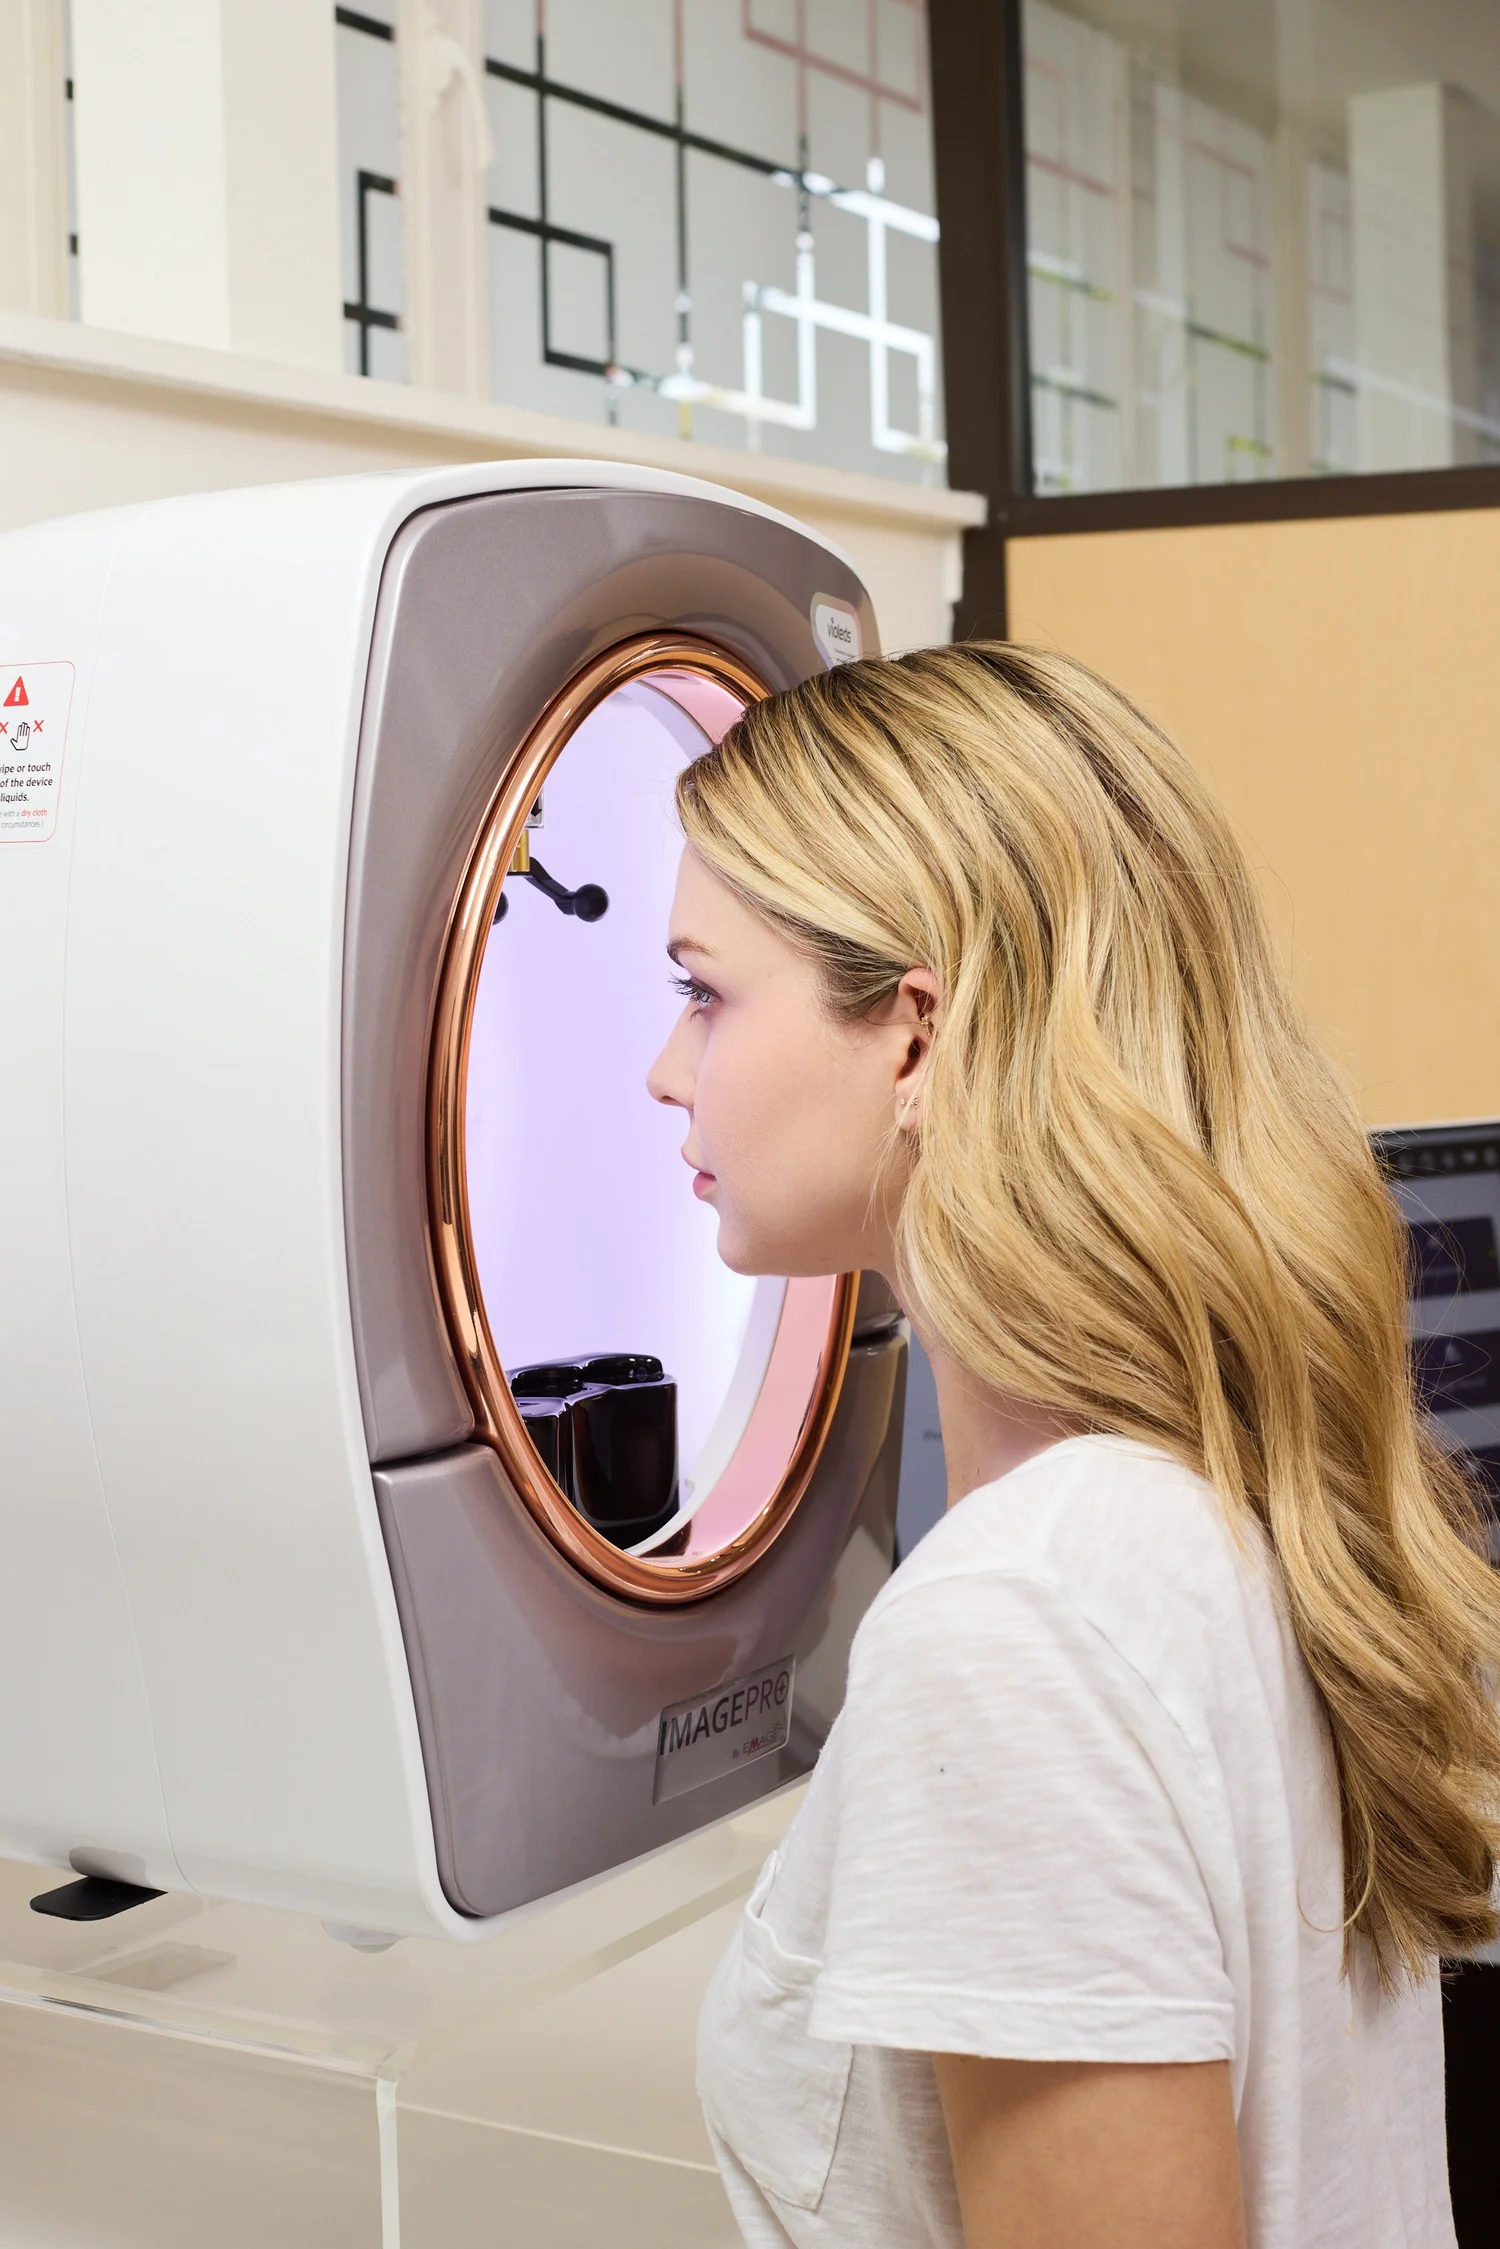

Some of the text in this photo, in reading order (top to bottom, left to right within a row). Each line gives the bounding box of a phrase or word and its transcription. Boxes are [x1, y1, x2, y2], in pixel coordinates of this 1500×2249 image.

[0, 762, 51, 775] ipe or touch
[0, 777, 53, 788] of the device
[0, 792, 29, 803] liquids.
[21, 809, 31, 818] dry
[32, 808, 48, 817] cloth
